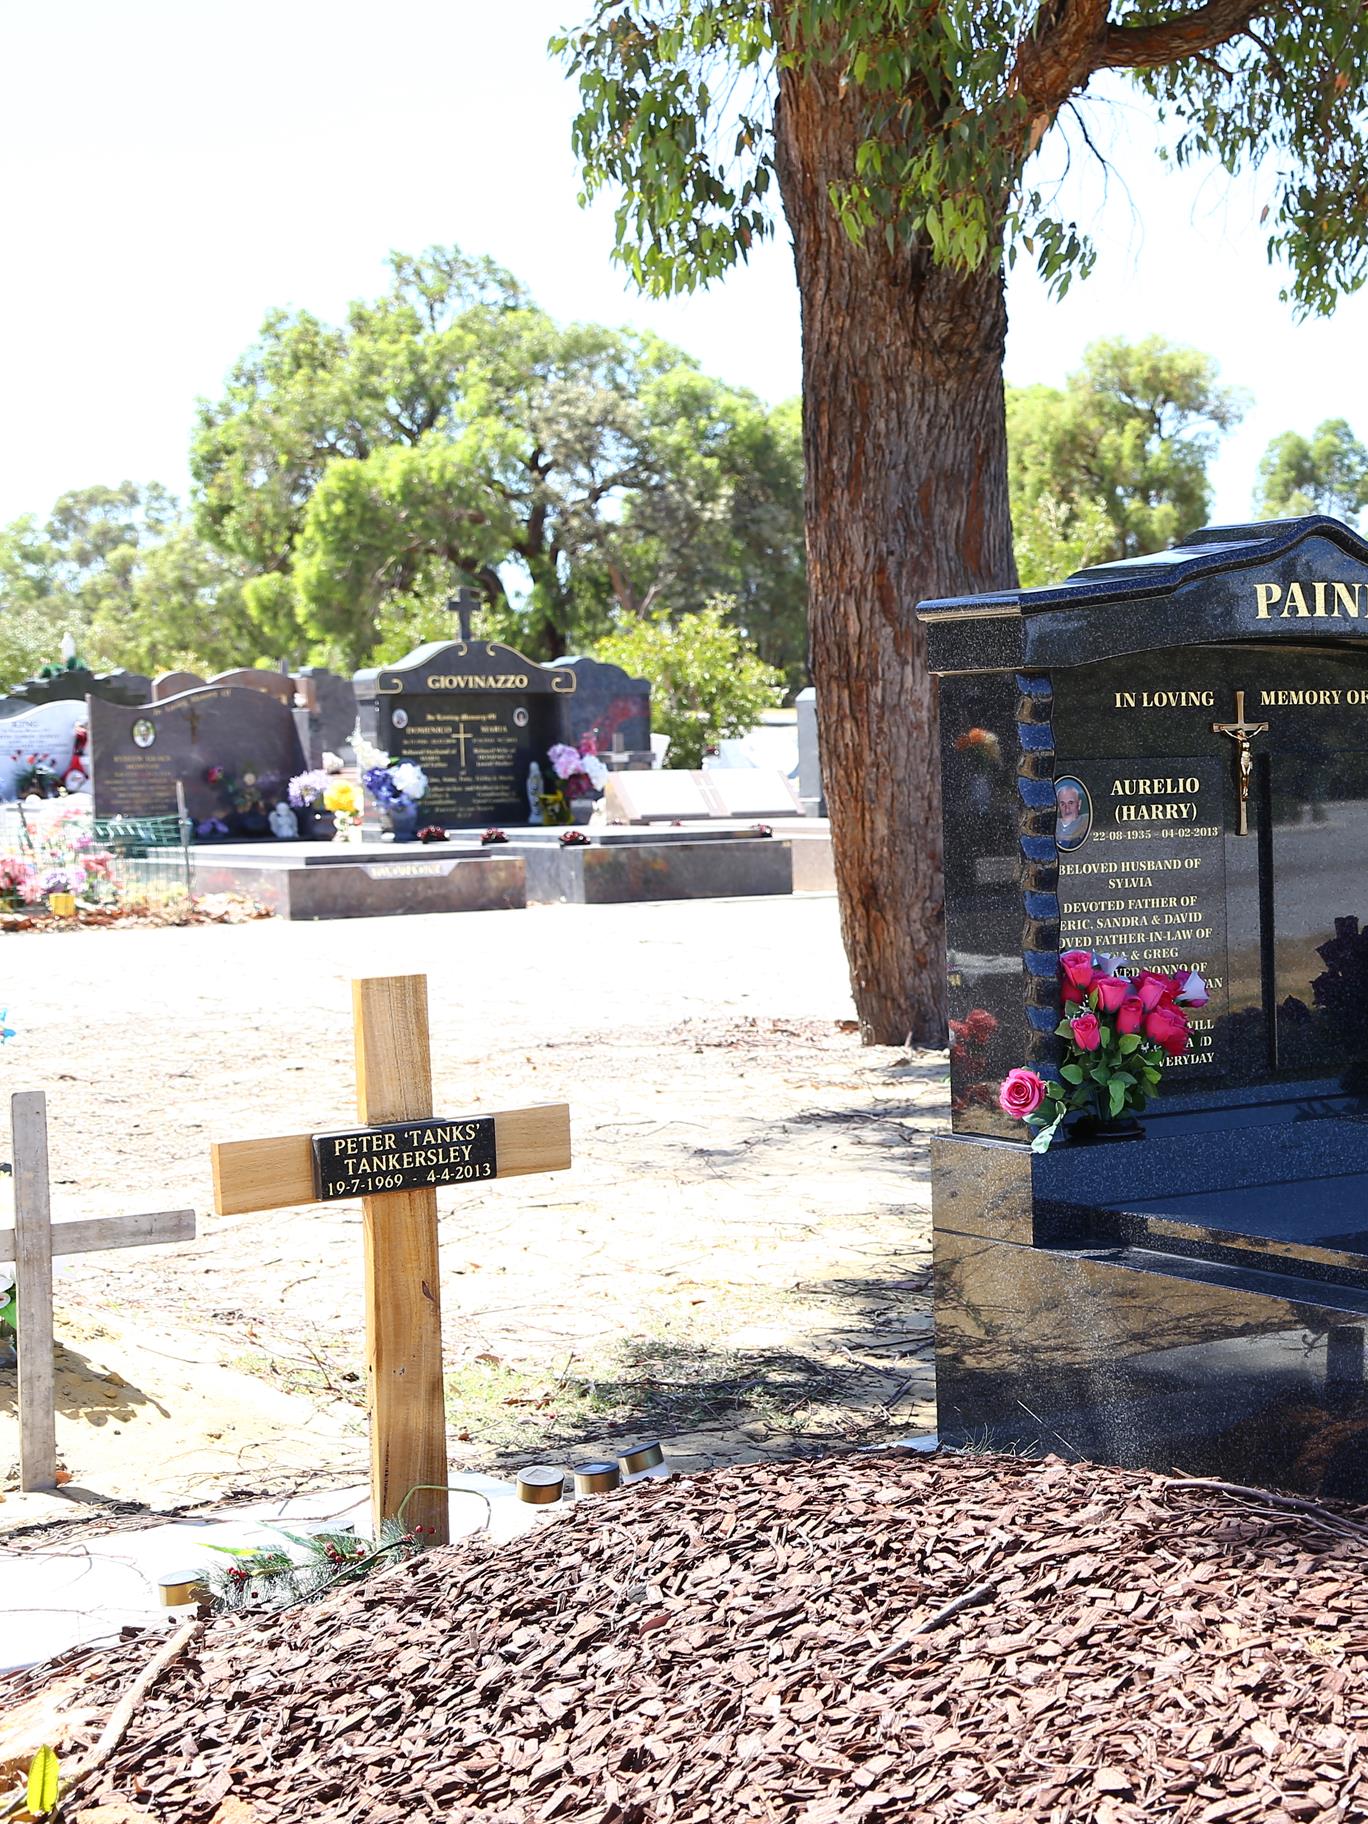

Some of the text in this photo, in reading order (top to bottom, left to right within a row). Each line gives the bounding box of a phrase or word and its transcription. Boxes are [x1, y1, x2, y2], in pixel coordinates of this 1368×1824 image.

[426, 674, 529, 690] GIOVINAZZO
[1114, 692, 1137, 708] IN
[1142, 691, 1214, 708] LOVING
[1260, 690, 1342, 706] MEMORY
[1110, 777, 1200, 796] AURELIO
[1114, 803, 1198, 824] (HARRY)
[1092, 828, 1152, 841] 22-08-1935
[1161, 826, 1219, 839] 04-02-2013
[1058, 857, 1202, 876] BELOVED HUSBAND OF
[1108, 877, 1153, 889] SYLVIA
[1063, 895, 1198, 914] DEVOTED FATHER OF
[1096, 916, 1149, 929] SANDRA
[1151, 914, 1161, 925] &
[1164, 912, 1202, 924] DAVID
[1058, 928, 1213, 949] OVED FATHER-IN-LAW OF
[1130, 949, 1140, 961] &
[1143, 948, 1179, 960] GREG
[1190, 962, 1208, 973] OF
[1159, 1052, 1215, 1067] VERYDAY
[334, 1123, 481, 1157] PETER 'TANKS'
[344, 1145, 473, 1176] TANKERSLEY
[328, 1174, 404, 1196] 19-7-1969
[426, 1163, 492, 1184] 4-4-2013
